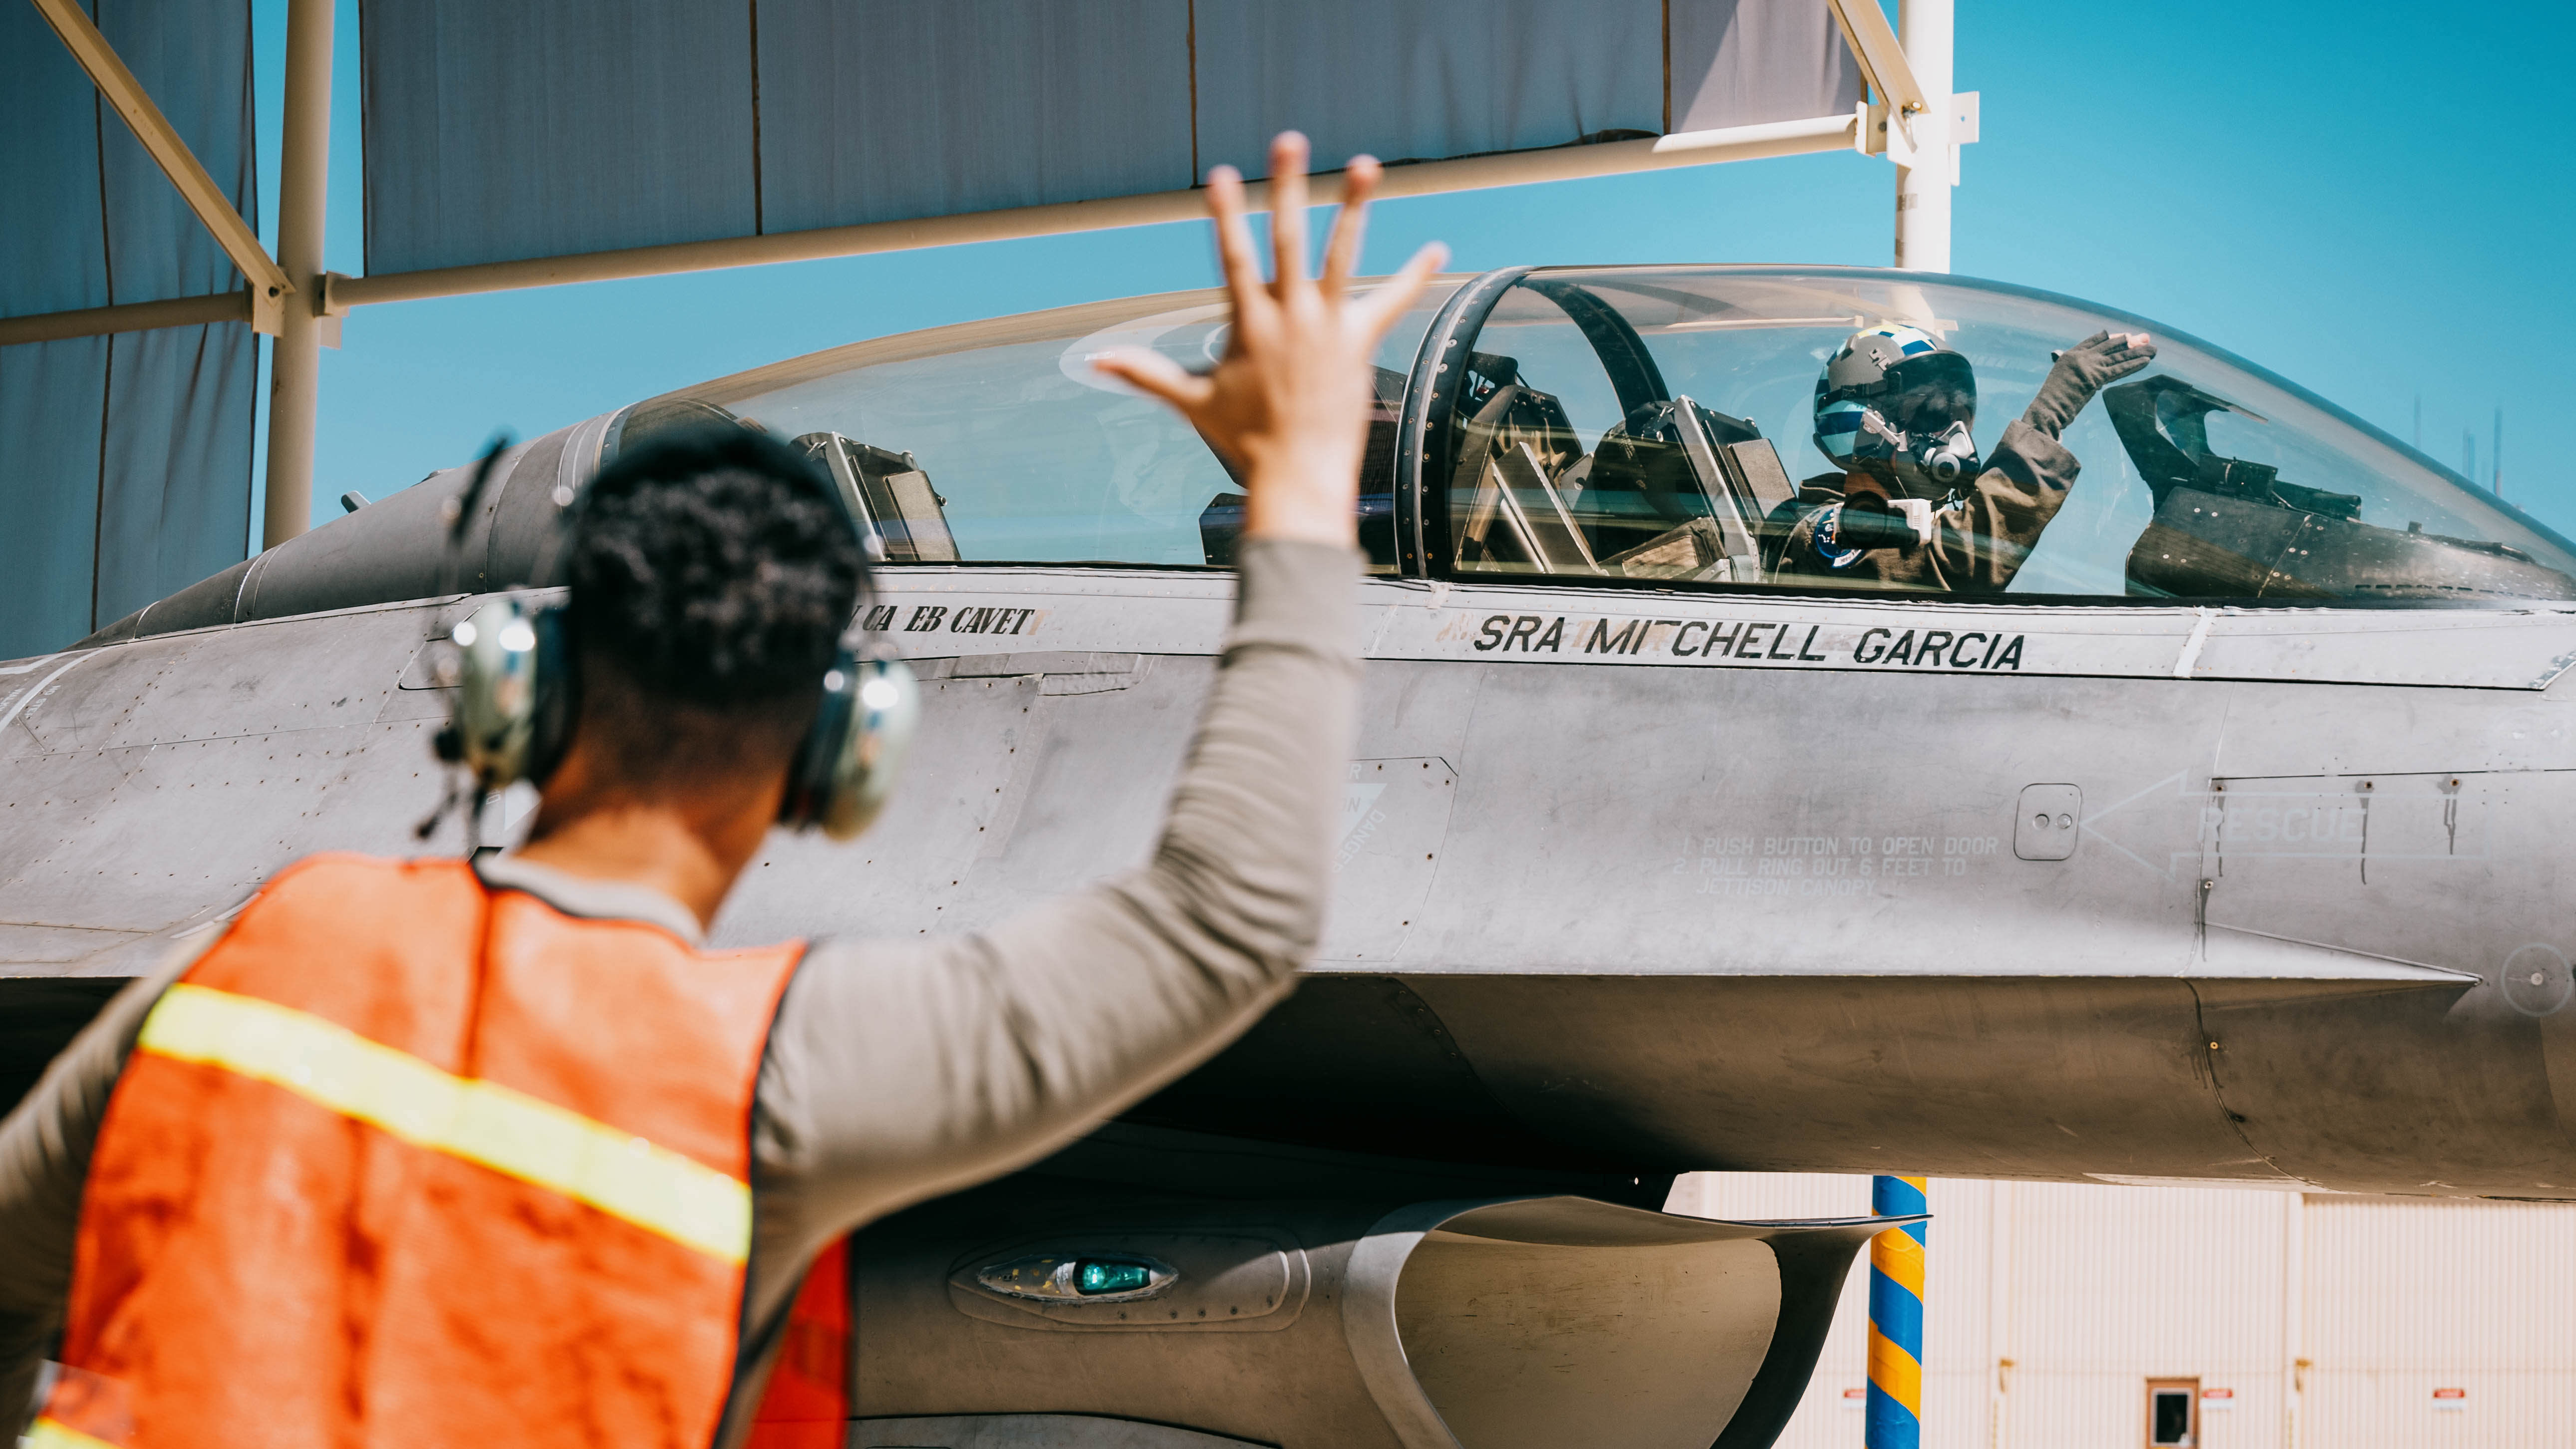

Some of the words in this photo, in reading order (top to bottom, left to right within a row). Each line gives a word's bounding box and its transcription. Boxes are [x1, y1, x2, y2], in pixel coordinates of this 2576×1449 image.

[1473, 615, 1565, 652] SRA
[1853, 627, 2024, 670] GARCIA
[2197, 807, 2367, 843] RESCUE
[1703, 838, 1753, 855] PUSH
[1763, 837, 1840, 855] BUTTON
[1849, 837, 1872, 855] TO
[1882, 837, 1935, 855] OPEN
[1945, 837, 1999, 855] DOOR
[1673, 858, 1691, 875] 2.
[1699, 858, 1748, 875] PULL
[1757, 858, 1803, 875] RING
[1812, 858, 1850, 875] OUT
[1859, 858, 1872, 875] 6
[1881, 858, 1933, 876] FEET
[1944, 858, 1966, 876] TO
[1696, 878, 1790, 895] JETTISON
[1800, 878, 1877, 895] CANOPY
